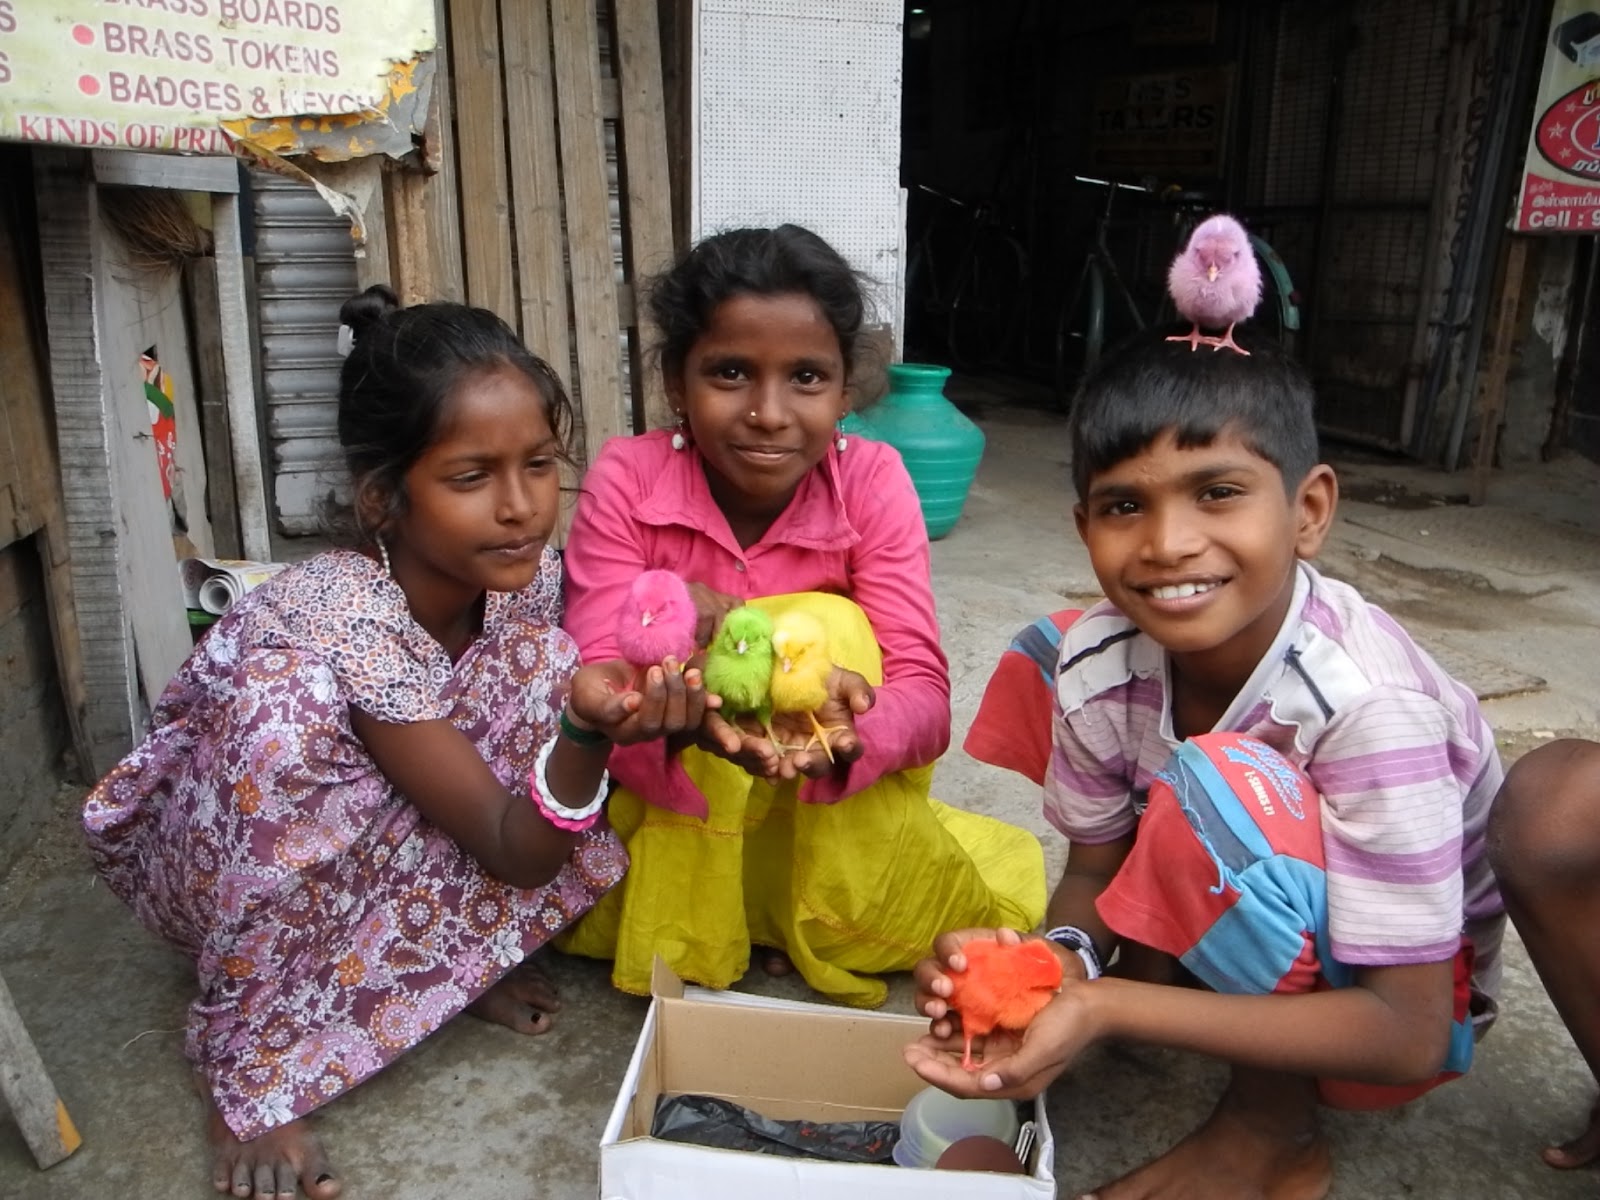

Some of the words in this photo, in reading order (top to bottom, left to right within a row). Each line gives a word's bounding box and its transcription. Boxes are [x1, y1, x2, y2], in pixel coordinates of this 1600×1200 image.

[220, 0, 341, 34] BOARDS
[103, 22, 213, 64] BRASS
[222, 38, 339, 77] TOKENS
[109, 72, 242, 112] BADGES
[250, 87, 270, 114] &
[20, 115, 117, 147] KINDS
[125, 123, 165, 149] OF
[1528, 211, 1571, 228] Cell
